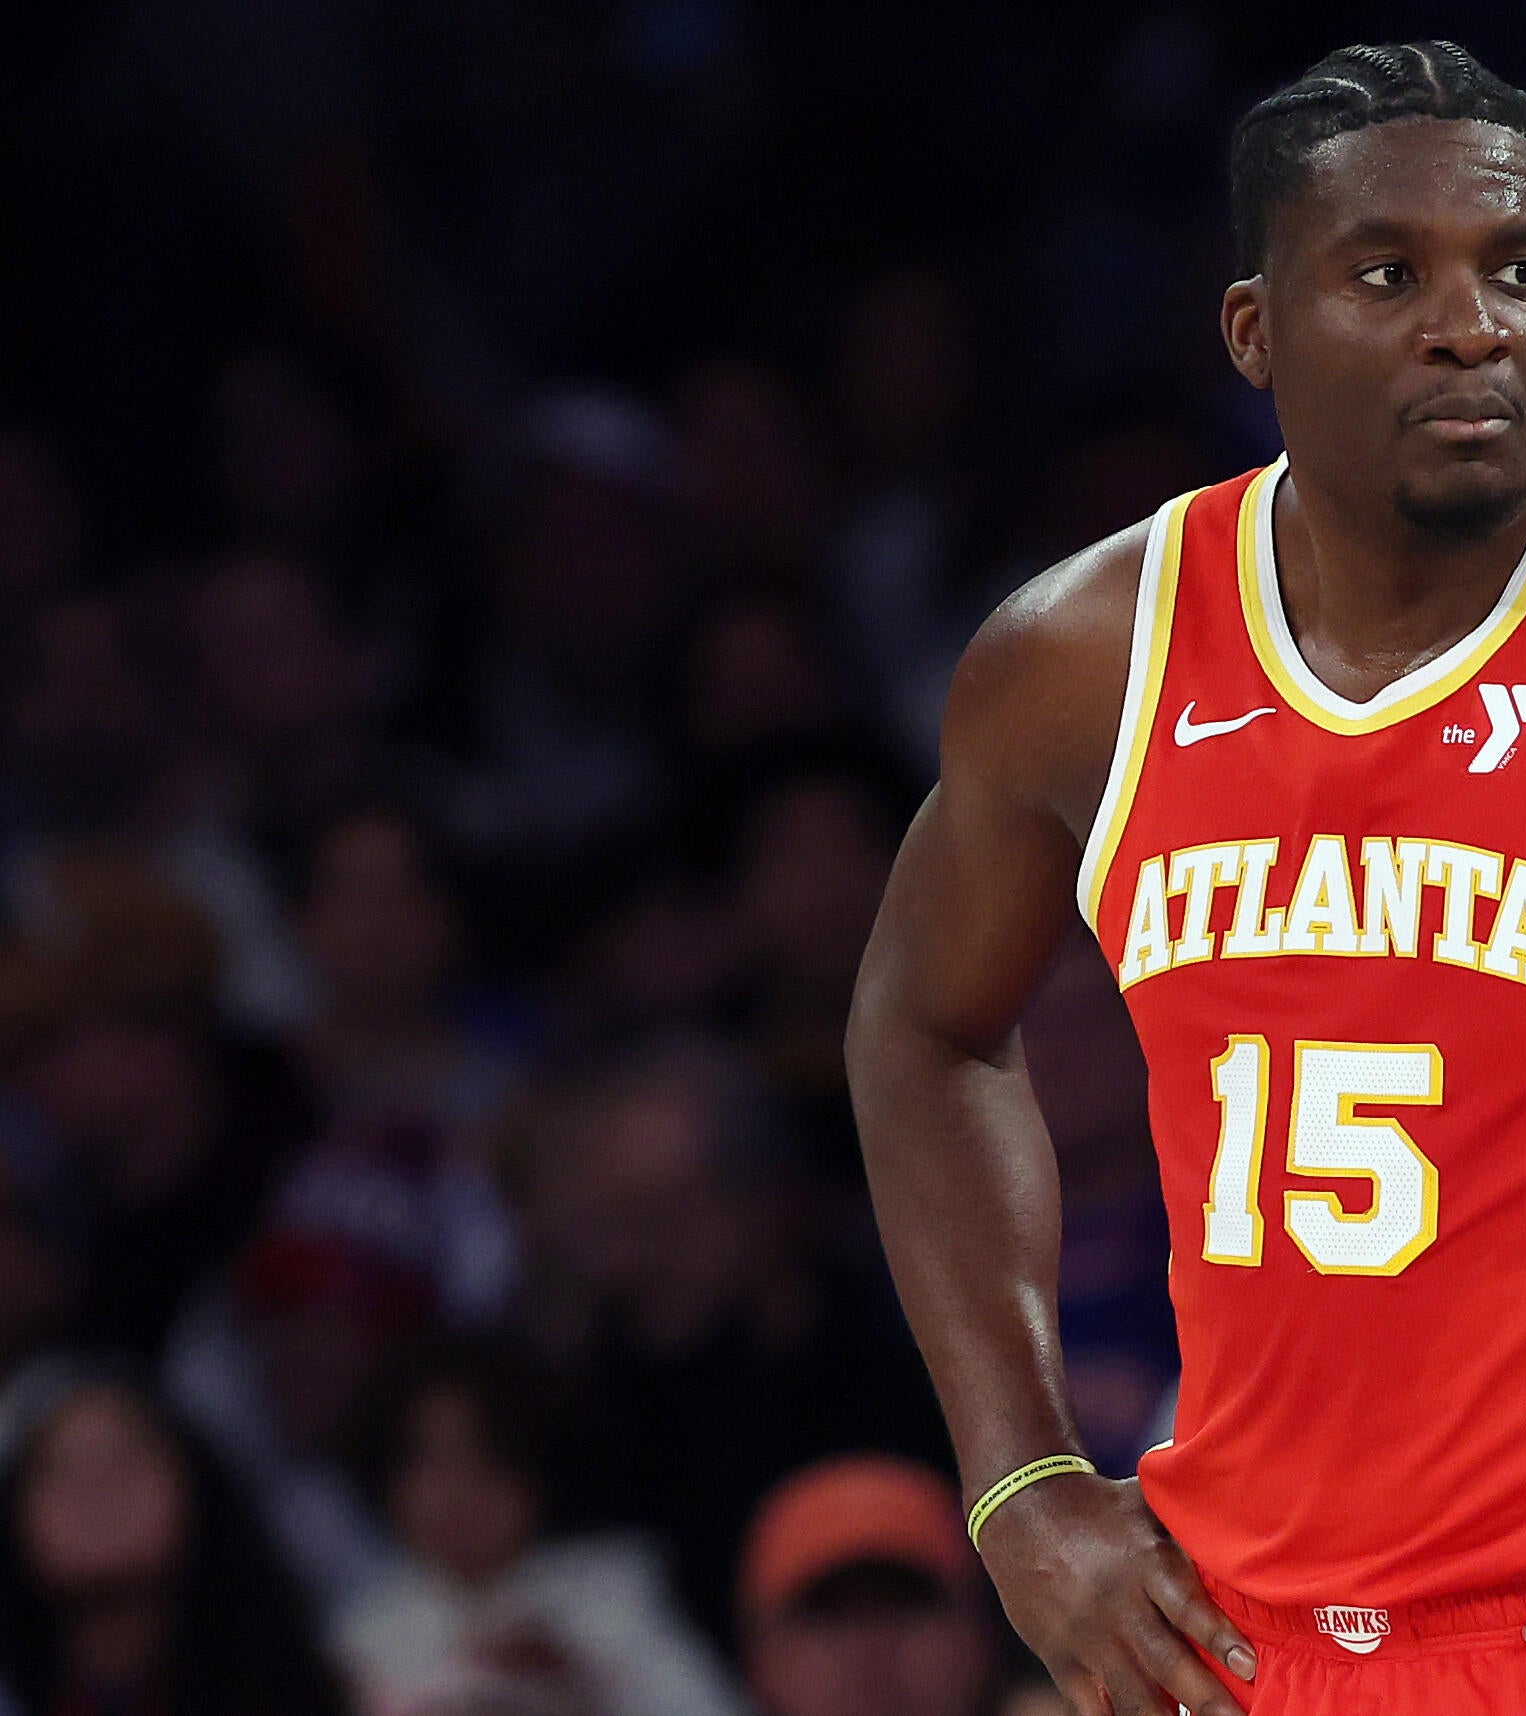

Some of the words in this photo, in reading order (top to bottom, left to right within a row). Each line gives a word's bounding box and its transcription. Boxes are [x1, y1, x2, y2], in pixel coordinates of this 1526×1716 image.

[1442, 724, 1475, 744] the
[1498, 747, 1517, 769] YMCA
[1202, 1034, 1443, 1276] 15
[1012, 1475, 1022, 1483] OF
[1024, 1461, 1073, 1477] EXCELLENCE
[1314, 1607, 1390, 1634] HAWKS
